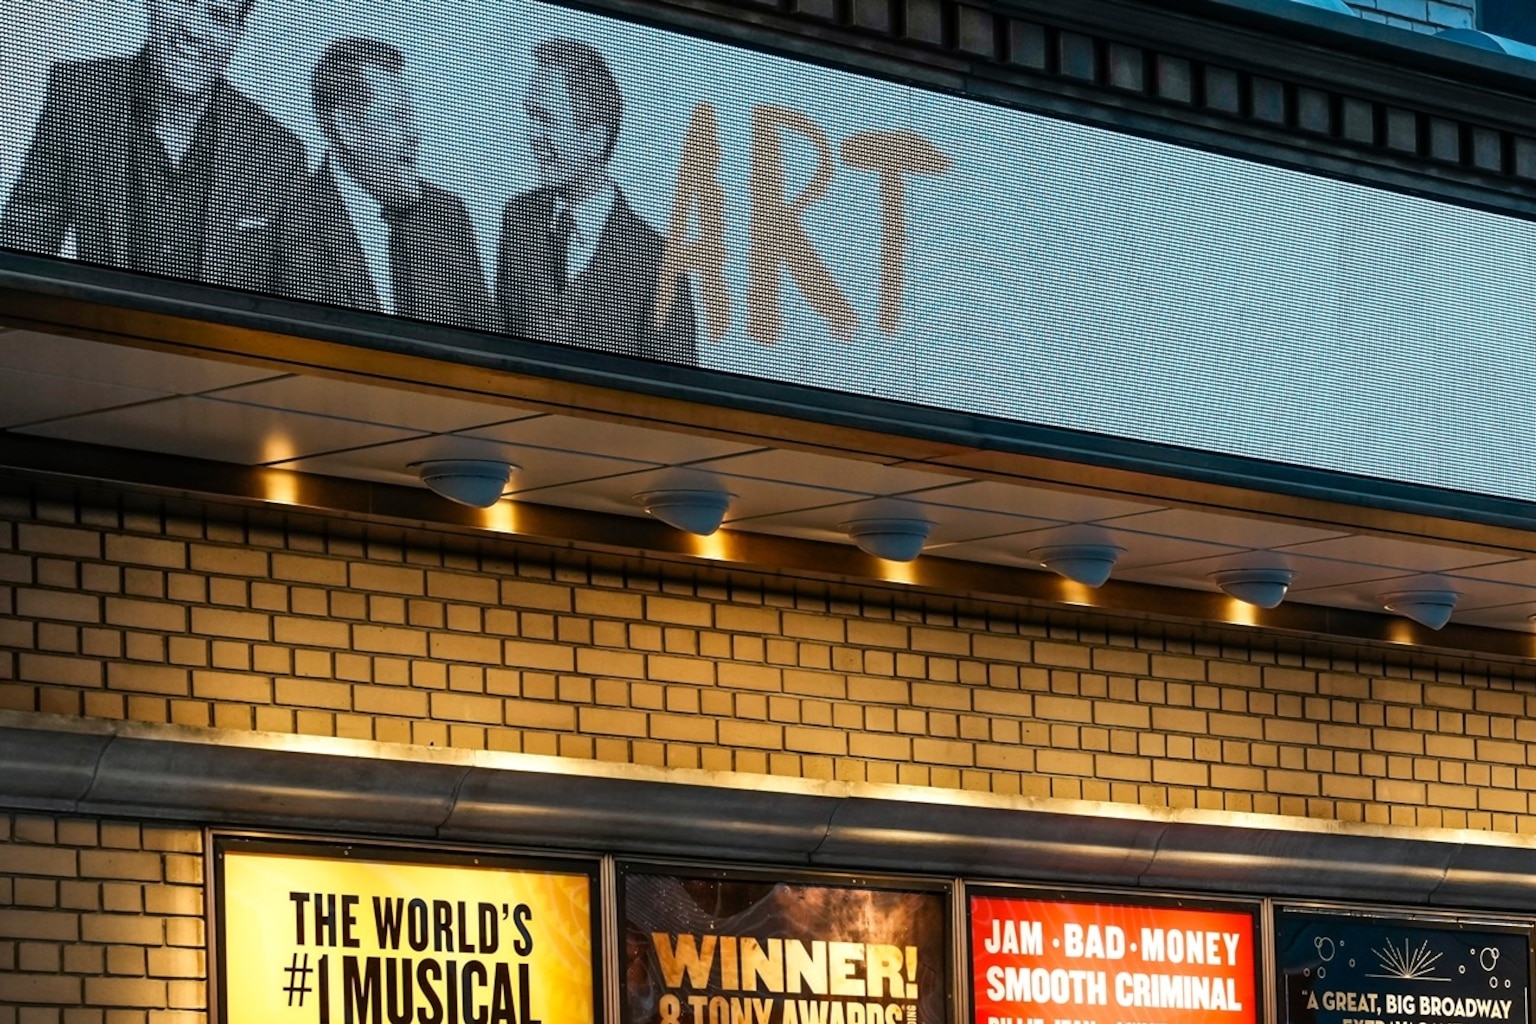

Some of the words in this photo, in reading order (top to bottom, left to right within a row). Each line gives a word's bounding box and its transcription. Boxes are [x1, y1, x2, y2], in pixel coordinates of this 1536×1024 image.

[651, 101, 950, 345] ART
[289, 891, 360, 948] THE
[372, 896, 533, 957] WORLD'S
[985, 919, 1043, 955] JAM
[1064, 923, 1126, 959] BAD
[1141, 928, 1240, 966] MONEY
[651, 932, 918, 999] WINNER!
[986, 966, 1107, 1005] SMOOTH
[1115, 972, 1242, 1011] CRIMINAL
[1322, 991, 1382, 1015] GREAT,
[1385, 994, 1415, 1015] BIG
[1419, 996, 1512, 1019] BROADWAY
